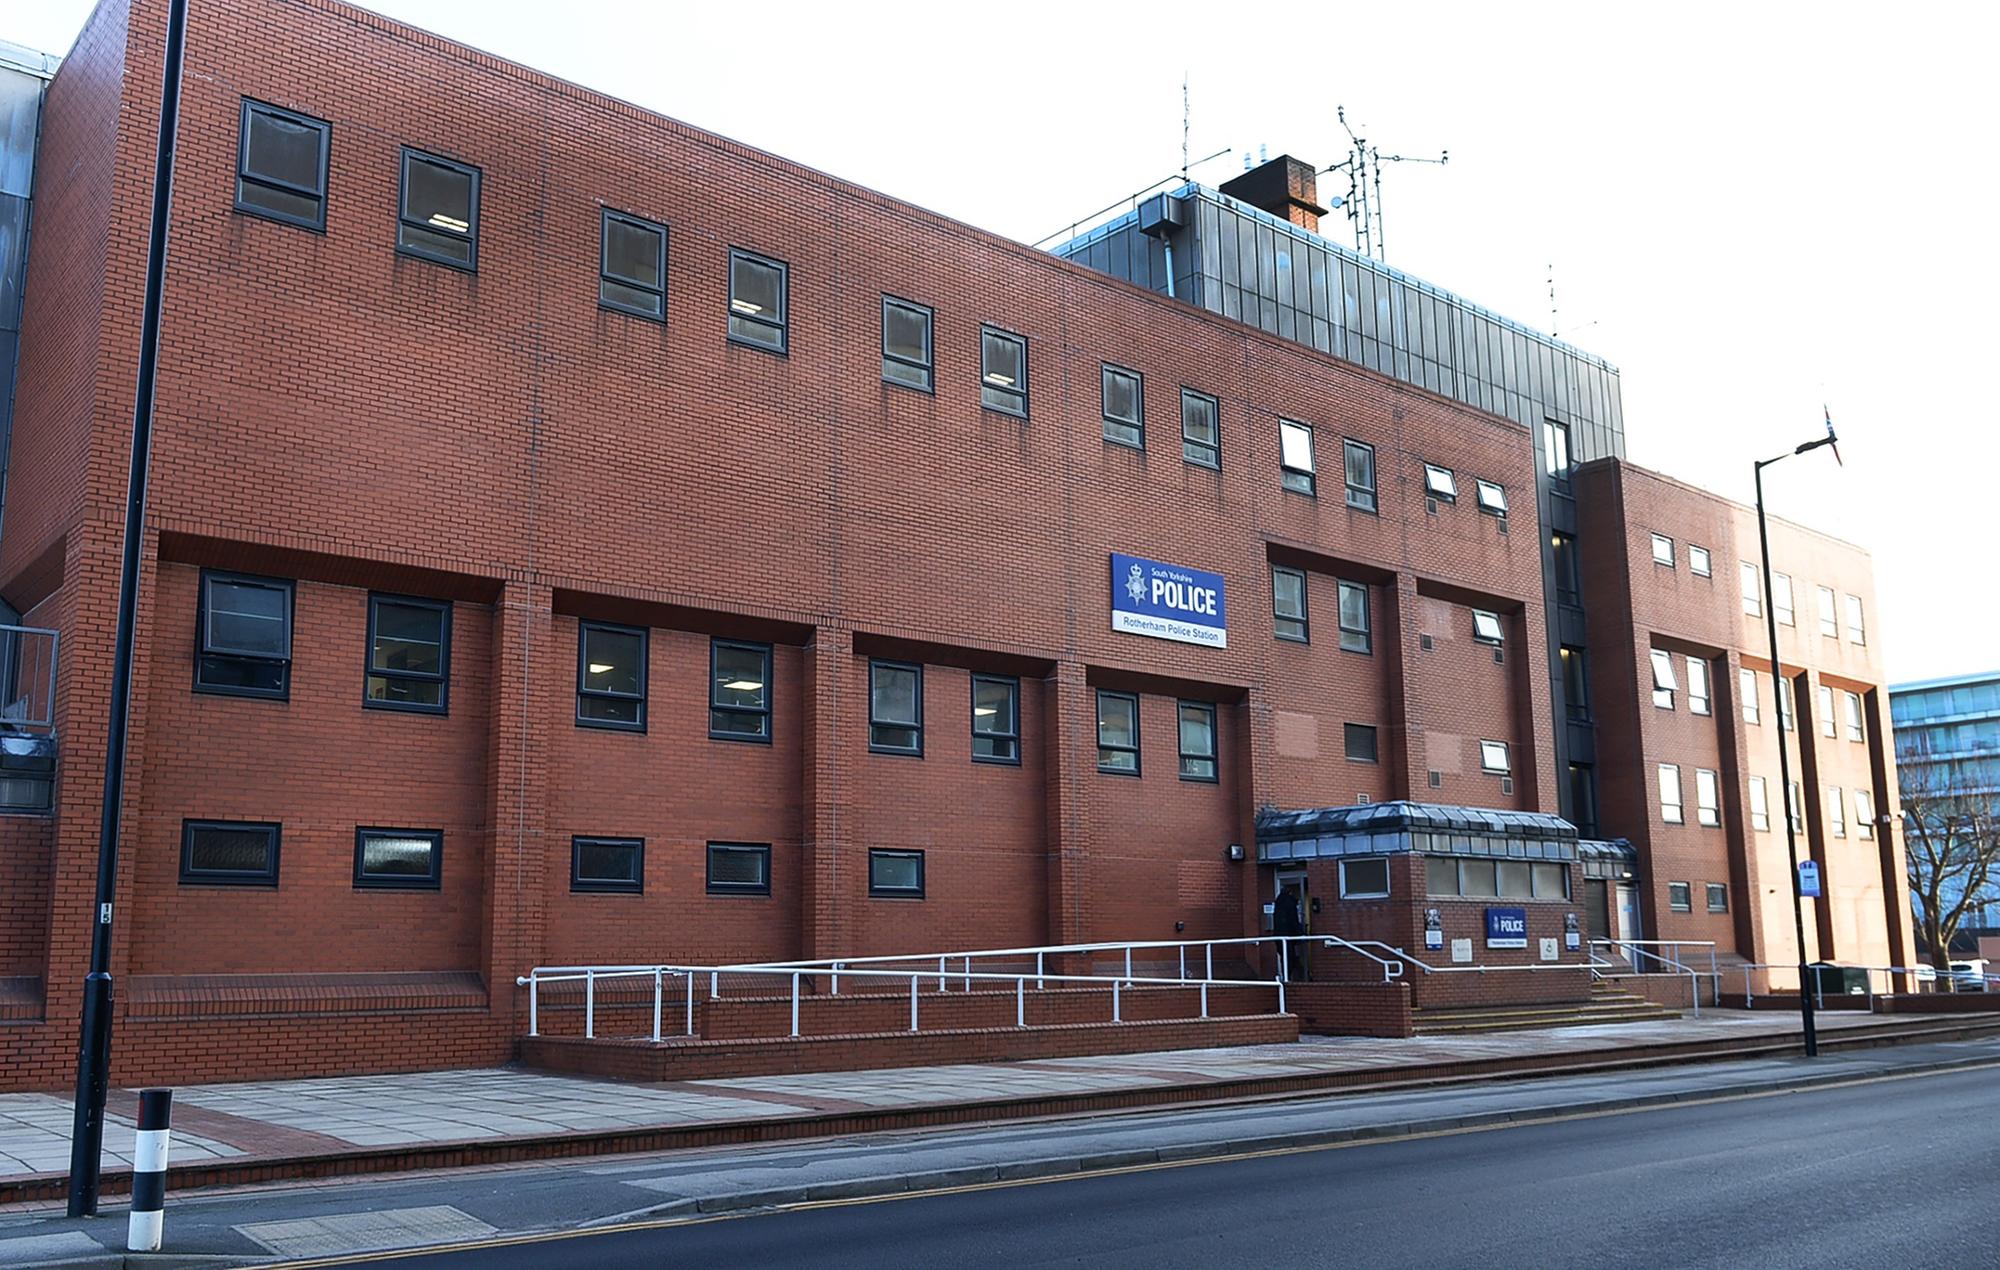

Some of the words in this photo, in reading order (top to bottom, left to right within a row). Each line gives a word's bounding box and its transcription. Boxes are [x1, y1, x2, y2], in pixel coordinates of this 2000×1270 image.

[1151, 567, 1168, 579] South
[1151, 578, 1217, 616] POLICE
[1123, 616, 1166, 632] Rotherham
[1168, 623, 1191, 637] Police
[1192, 628, 1218, 641] Station
[1500, 919, 1524, 932] POLICE
